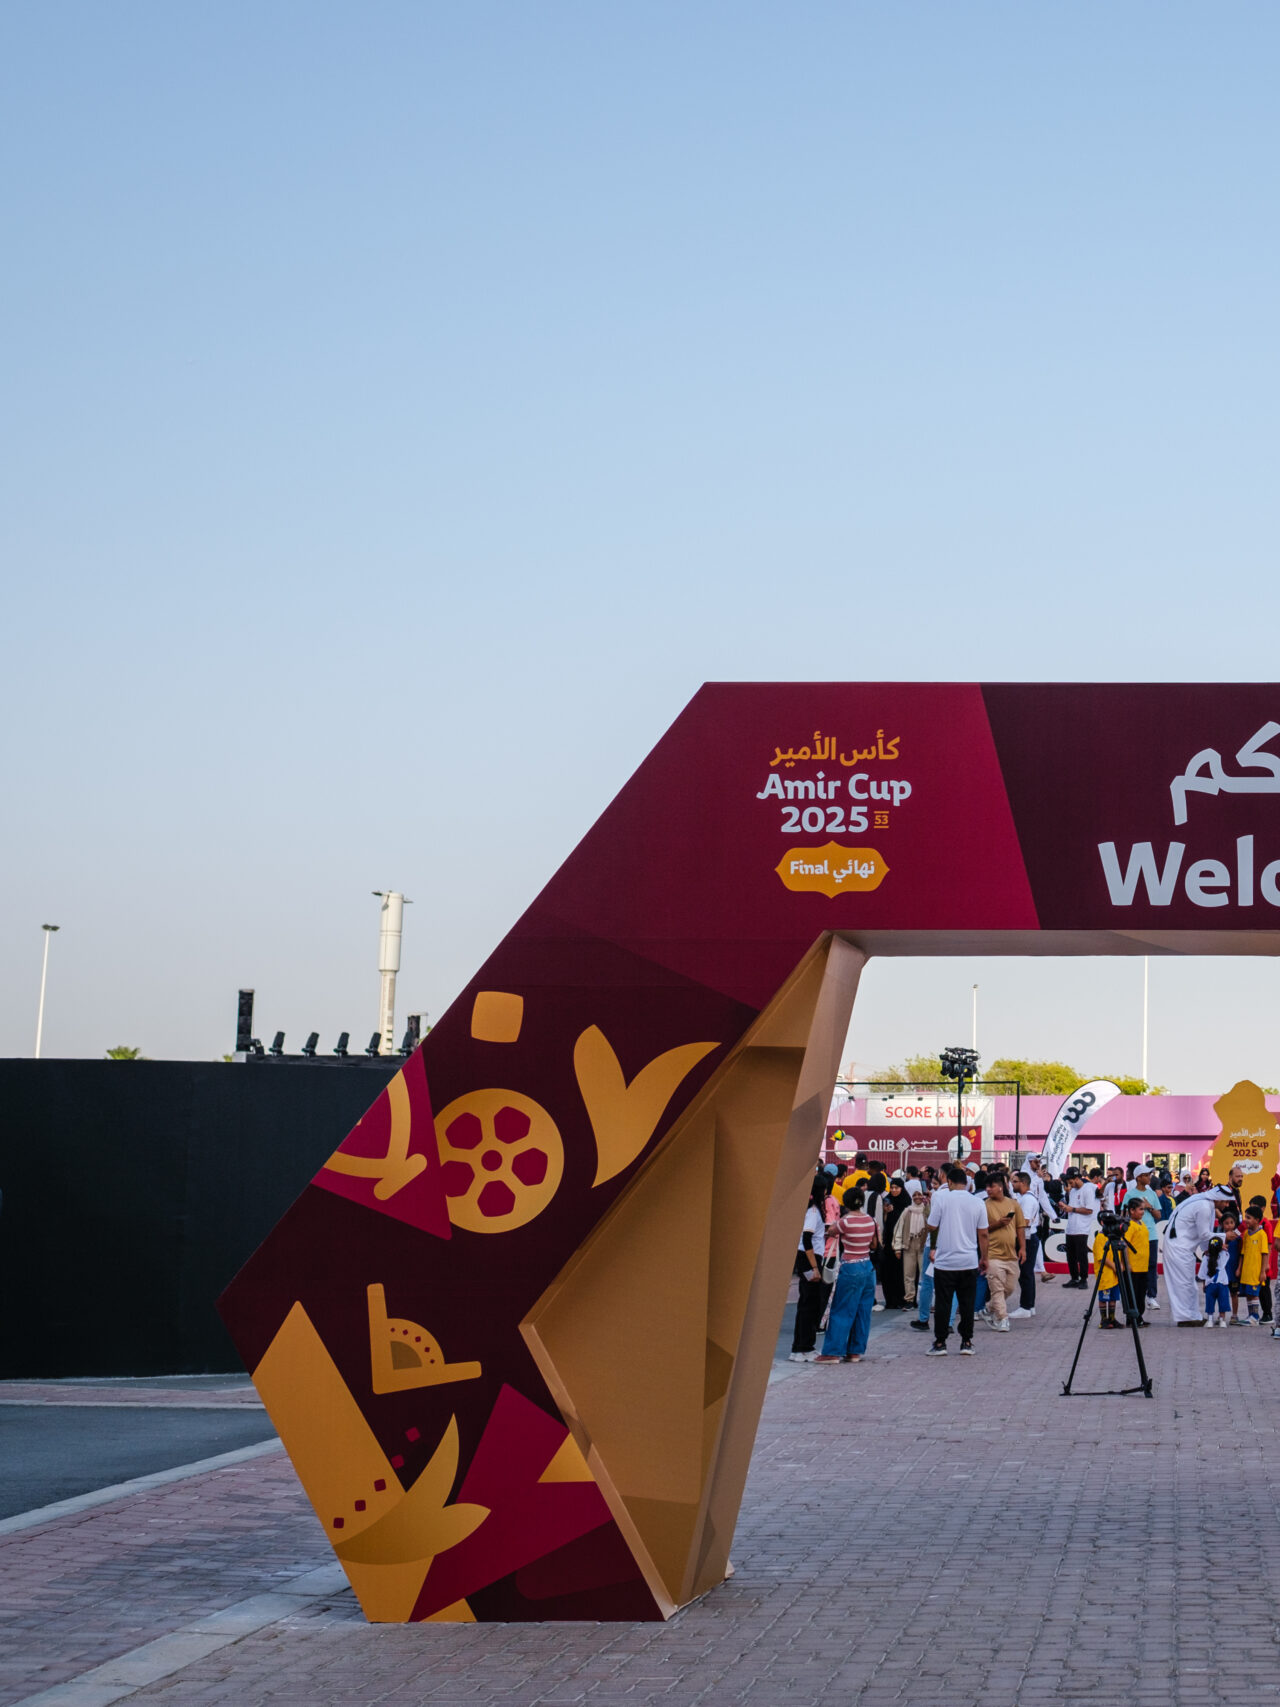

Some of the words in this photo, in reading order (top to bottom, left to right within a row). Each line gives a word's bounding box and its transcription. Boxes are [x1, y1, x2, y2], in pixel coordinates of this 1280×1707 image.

[769, 730, 837, 768] الأمير
[839, 729, 900, 767] كأس
[756, 771, 841, 800] Amir
[848, 773, 912, 806] Cup
[781, 806, 869, 833] 2025
[874, 814, 889, 825] 53
[790, 860, 829, 875] Final
[833, 859, 875, 883] نهائي
[885, 1106, 932, 1118] SCORE
[935, 1106, 945, 1118] &
[948, 1106, 976, 1118] WIN
[868, 1139, 895, 1151] QIIB
[1226, 1139, 1250, 1148] Amir
[1251, 1140, 1269, 1149] Cup
[1233, 1149, 1257, 1157] 2025
